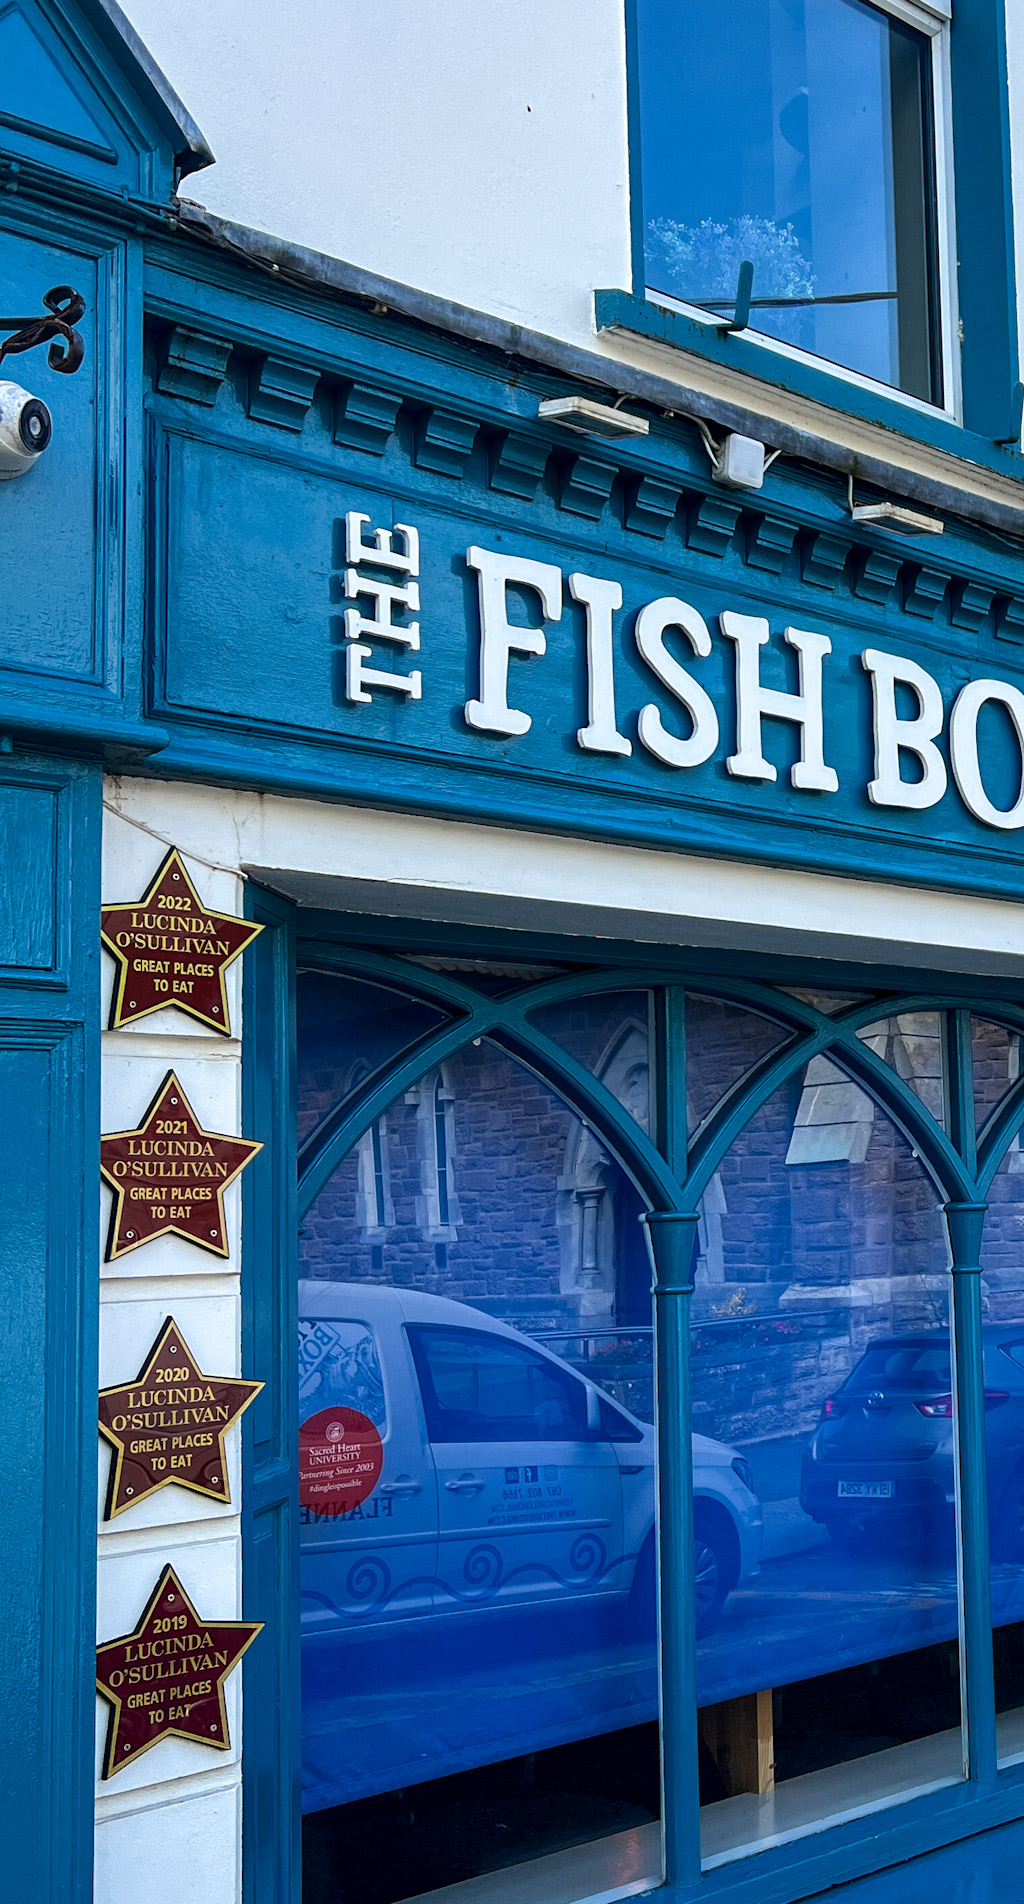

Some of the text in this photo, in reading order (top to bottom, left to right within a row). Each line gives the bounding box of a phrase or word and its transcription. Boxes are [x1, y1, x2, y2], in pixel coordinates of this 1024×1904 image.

[344, 511, 422, 703] THE
[464, 545, 840, 792] FISH
[158, 895, 192, 912] 2022
[131, 912, 216, 936] LUCINDA
[116, 932, 230, 957] O'SULLIVAN
[133, 959, 214, 978] GREAT PLACES
[154, 979, 194, 994] TO EAT
[155, 1120, 188, 1135] 2021
[128, 1139, 215, 1158] LUCINDA
[112, 1161, 228, 1178] O'SULLIVAN
[130, 1186, 212, 1201] GREAT PLACES
[151, 1205, 191, 1219] TO EAT
[155, 1367, 190, 1383] 2020
[127, 1385, 215, 1408] LUCINDA
[111, 1406, 230, 1431] O'SULLIVAN
[129, 1433, 213, 1453] GREAT PLACES
[309, 1443, 361, 1457] Sacred Heart
[150, 1454, 192, 1470] TO EAT
[309, 1452, 361, 1465] UNIVERSITY
[335, 1466, 354, 1475] Since
[355, 1462, 374, 1473] 2003
[153, 1615, 188, 1633] 2019
[124, 1631, 214, 1662] LUCINDA
[109, 1650, 228, 1688] O'SULLIVAN
[127, 1680, 212, 1709] GREAT PLACES
[148, 1703, 191, 1723] TO EAT
